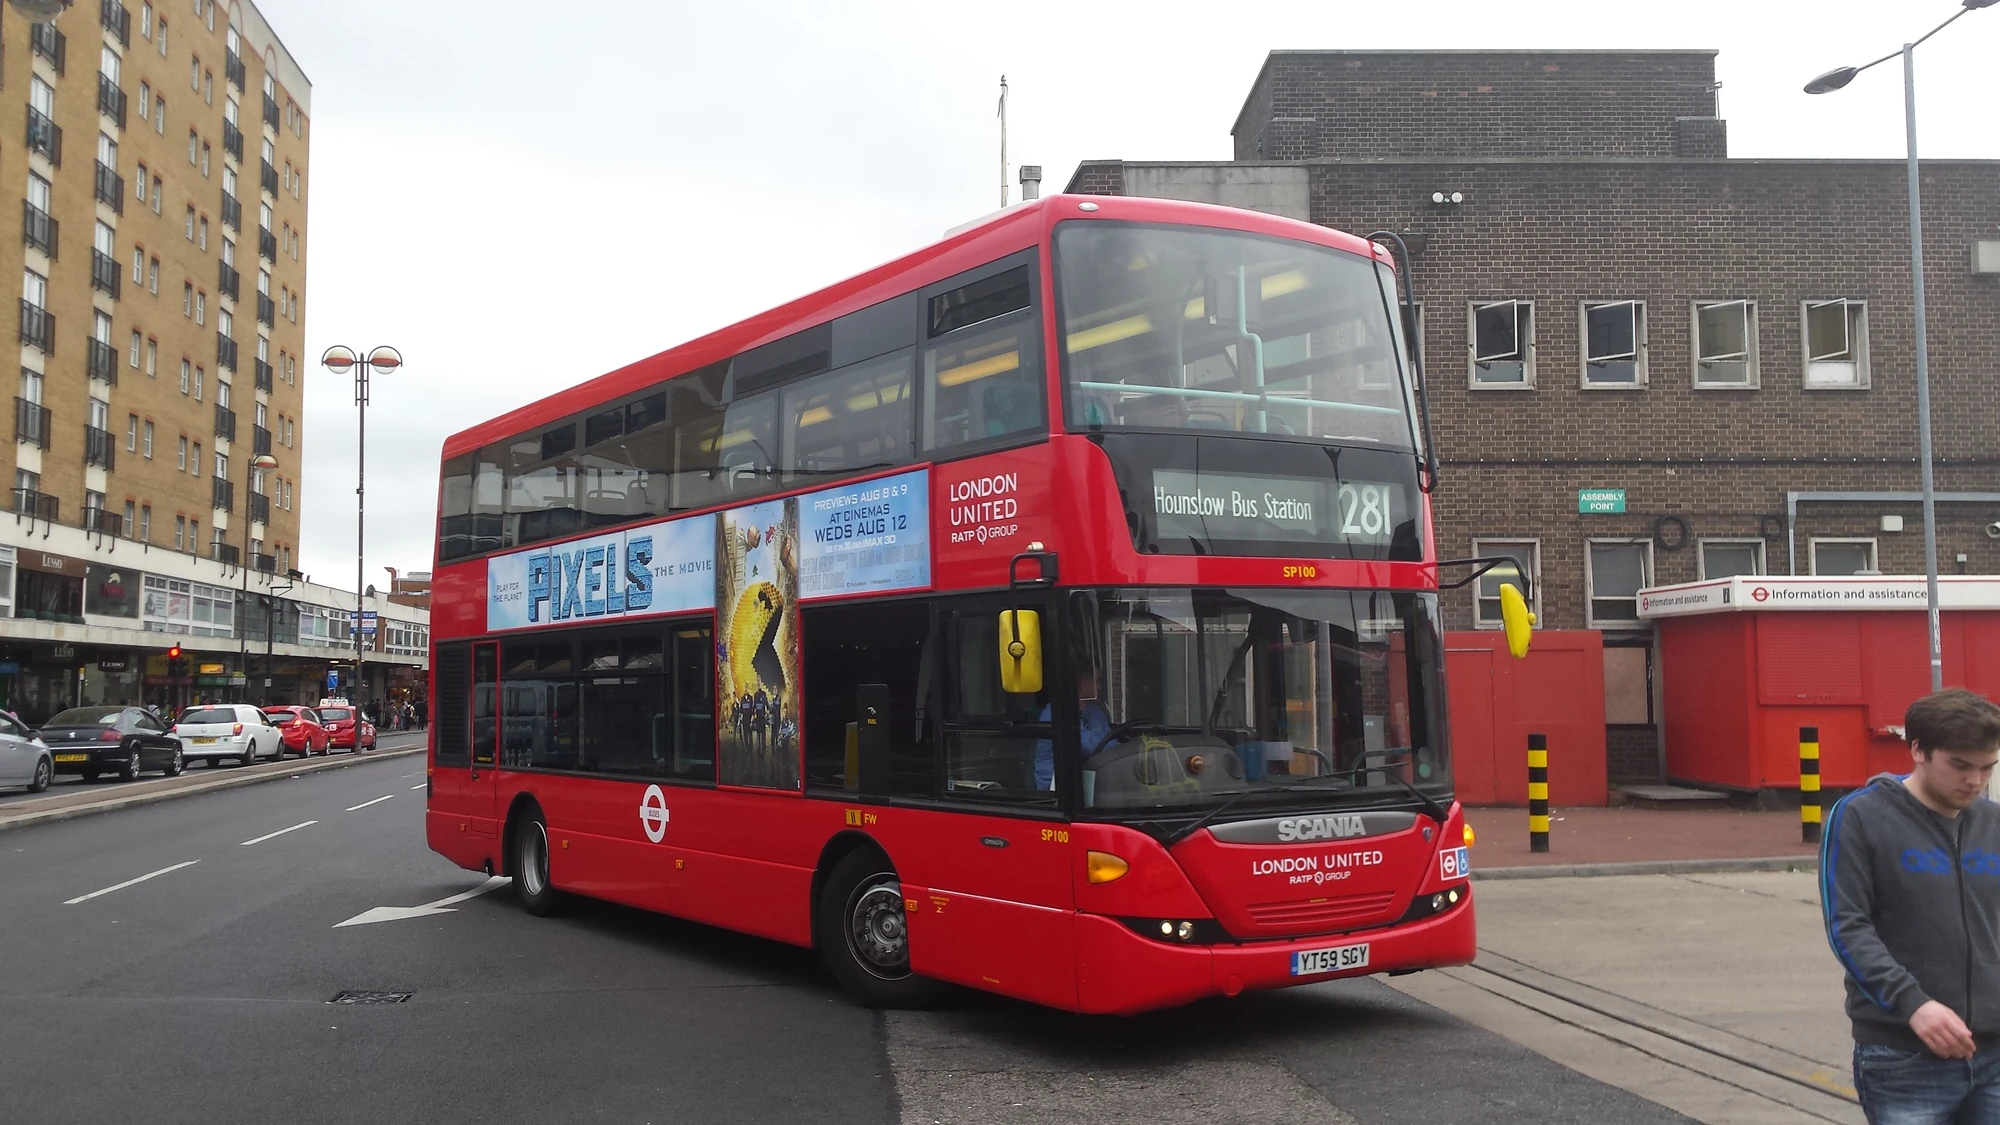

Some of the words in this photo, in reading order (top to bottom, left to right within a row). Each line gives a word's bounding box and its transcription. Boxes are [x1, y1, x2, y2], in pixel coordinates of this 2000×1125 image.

[951, 473, 1017, 502] LONDON
[1581, 493, 1623, 501] ASSEMBLY
[814, 494, 858, 511] PREVIEWS
[860, 489, 880, 503] AUG
[882, 487, 890, 498] 8
[891, 486, 899, 496] &
[901, 484, 908, 495] 9
[1154, 486, 1225, 517] Hounslow
[1232, 491, 1257, 518] Bus
[1264, 492, 1312, 521] Station
[829, 512, 842, 524] AT
[844, 503, 890, 522] CINEMAS
[951, 498, 1017, 526] UNITED
[1339, 484, 1391, 535] 281
[815, 524, 852, 543] WEDS
[857, 518, 885, 537] AUG
[892, 514, 907, 531] 12
[951, 530, 975, 543] RATP
[988, 524, 1018, 538] GROUP
[863, 536, 883, 548] IMAX
[884, 534, 896, 545] 3D
[528, 535, 653, 623] PIXELS
[654, 565, 674, 578] THE
[679, 560, 712, 574] MOVIE
[1283, 566, 1316, 578] SP100
[496, 584, 508, 592] PLAY
[510, 582, 519, 590] FOR
[1772, 589, 1840, 599] Information
[1844, 589, 1865, 599] and
[1868, 589, 1928, 599] assistance
[493, 594, 503, 603] THE
[504, 592, 522, 602] PLANET
[1649, 597, 1674, 607] Information
[1675, 596, 1683, 605] and
[1684, 594, 1708, 604] assistance
[648, 809, 660, 818] BUSES
[864, 814, 878, 824] FW
[1041, 829, 1069, 843] SP100
[1278, 816, 1366, 841] SCANIA
[1253, 856, 1317, 875] LONDON
[1324, 851, 1383, 869] UNITED
[1289, 875, 1312, 884] RATP
[1325, 871, 1351, 881] GROUP
[1301, 951, 1338, 971] YT59
[1341, 946, 1367, 965] SGY
